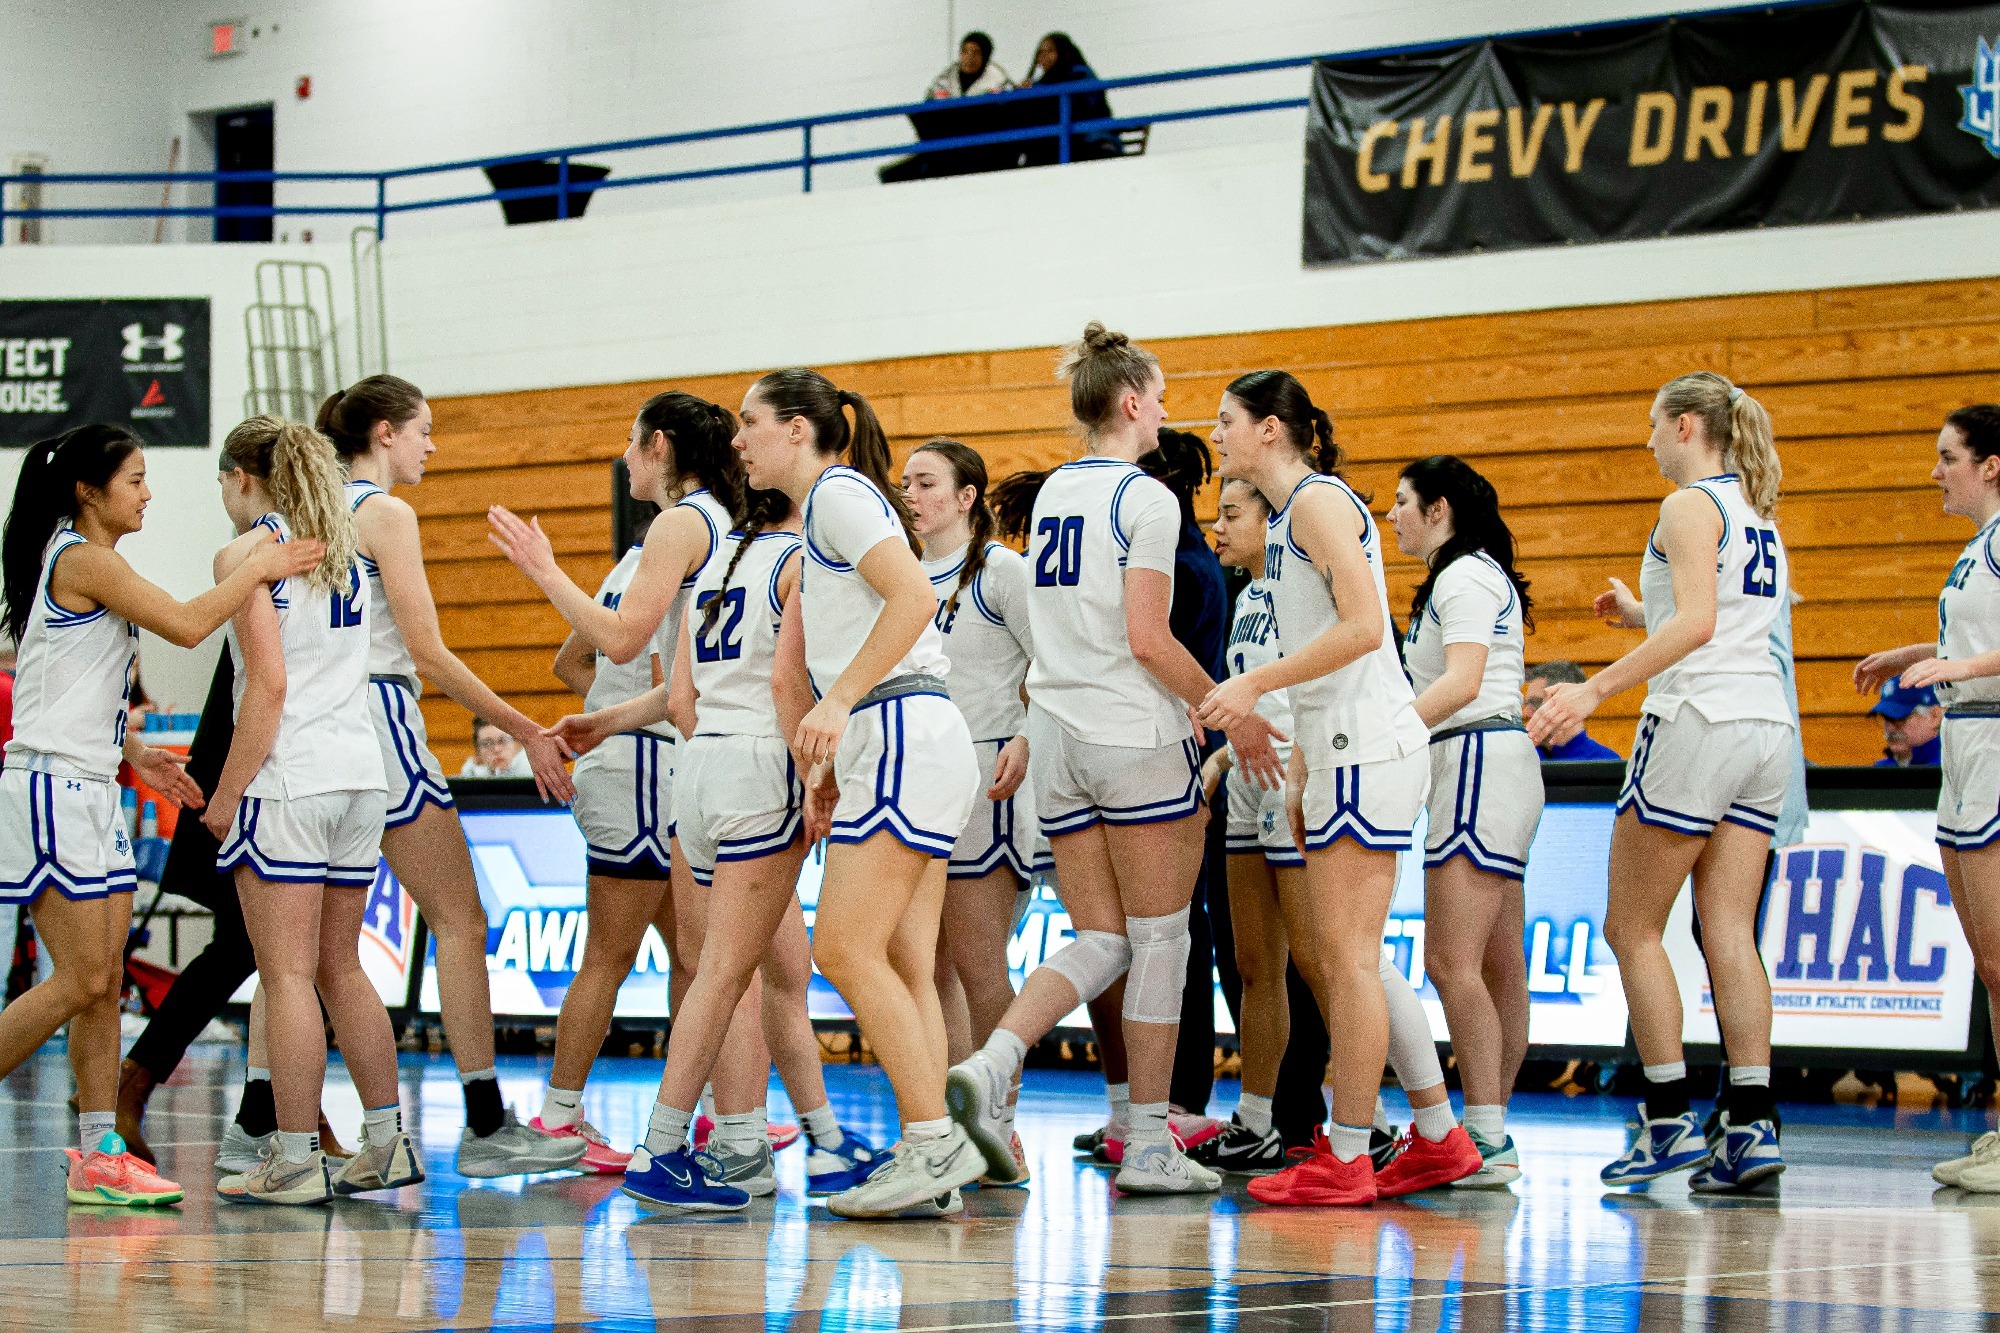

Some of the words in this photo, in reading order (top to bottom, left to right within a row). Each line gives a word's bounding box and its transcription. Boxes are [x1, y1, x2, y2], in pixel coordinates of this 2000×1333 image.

[1357, 98, 1605, 194] CHEVY
[1628, 64, 1927, 168] DRIVES
[0, 338, 71, 377] ECT
[1035, 515, 1084, 587] 20
[1743, 526, 1777, 598] 25
[329, 556, 363, 628] 12
[696, 586, 746, 663] 22
[1757, 849, 1952, 983] HAC
[1815, 994, 1866, 1009] ATHLETIC
[1870, 995, 1942, 1012] CONFERENCE
